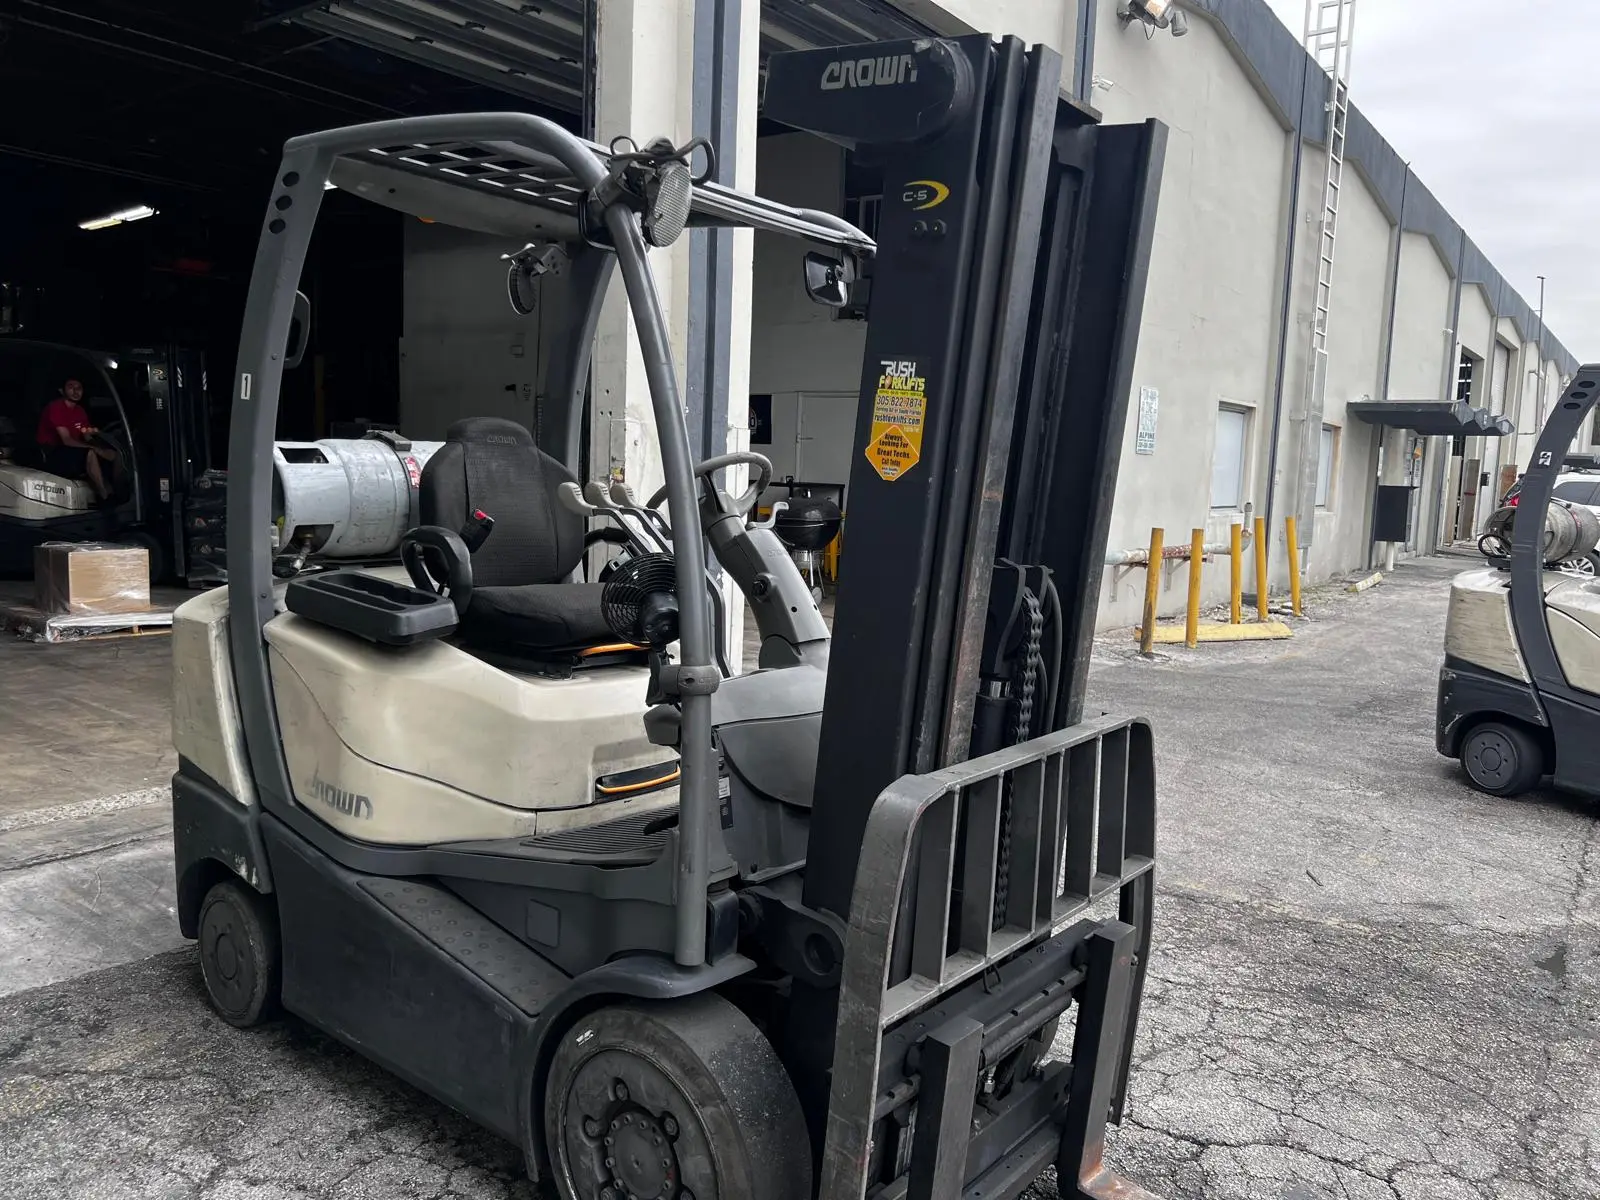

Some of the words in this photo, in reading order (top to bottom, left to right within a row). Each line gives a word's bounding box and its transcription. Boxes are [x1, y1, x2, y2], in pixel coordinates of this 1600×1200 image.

[820, 54, 918, 90] CROWN
[903, 189, 927, 202] C-5
[881, 360, 916, 377] RUSH
[880, 440, 900, 448] Looking
[877, 448, 892, 456] Great
[894, 450, 910, 458] Techs
[34, 483, 65, 495] CROWN
